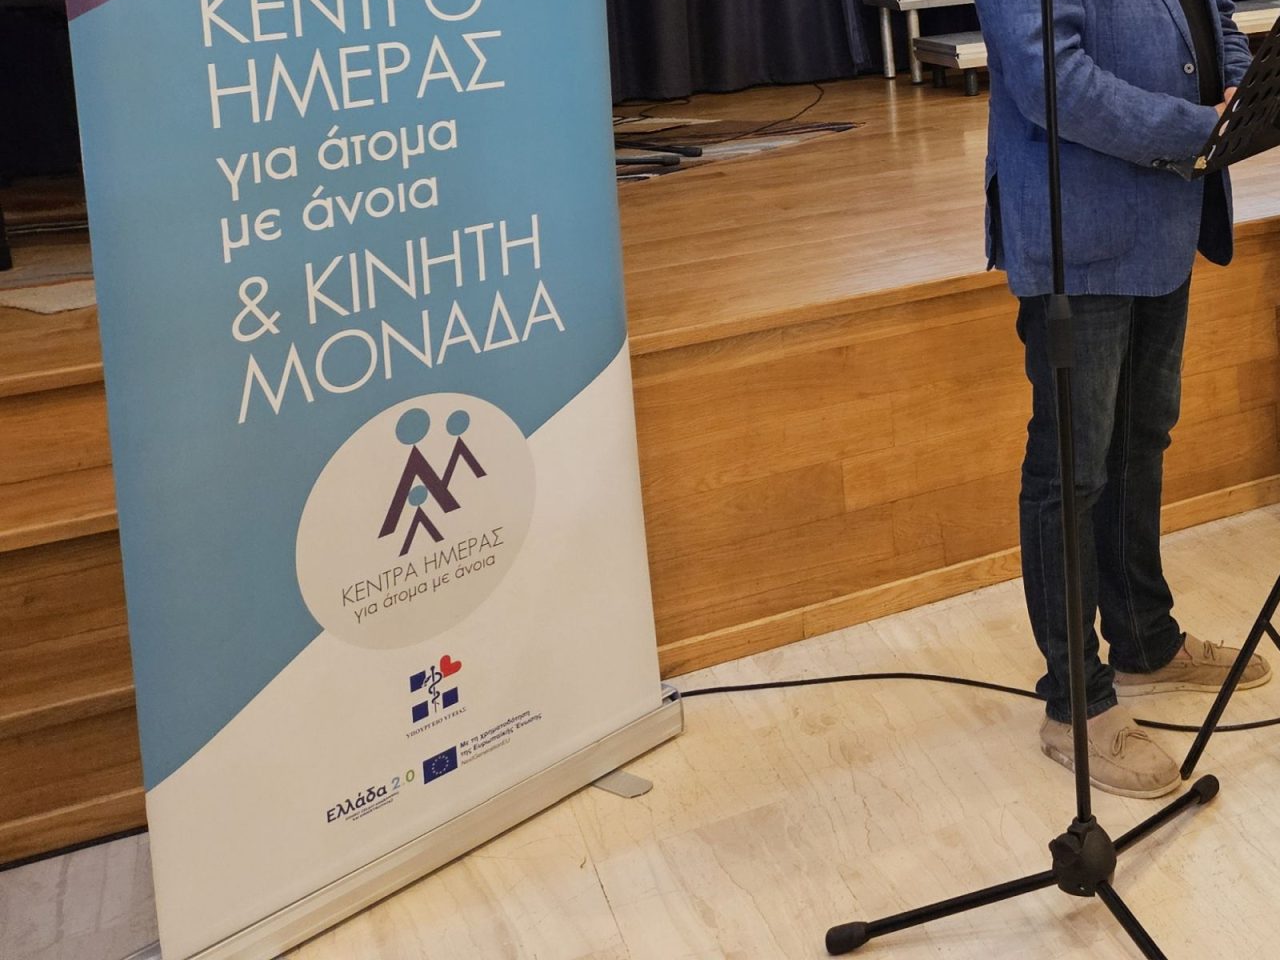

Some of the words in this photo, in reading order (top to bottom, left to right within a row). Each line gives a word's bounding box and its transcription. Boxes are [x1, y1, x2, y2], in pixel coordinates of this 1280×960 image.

[207, 30, 505, 129] ΗΜΕΡΑΣ
[216, 145, 298, 201] για
[317, 119, 459, 170] άτομα
[221, 207, 282, 263] με
[302, 176, 439, 231] άνοια
[231, 275, 281, 342] &
[305, 213, 542, 325] ΚΙΝΗΤΗ
[238, 279, 566, 425] ΜΟΝΑΔΑ
[341, 561, 419, 607] ΚΕΝΤΡΑ
[423, 526, 505, 574] ΗΜΕΡΑΣ
[354, 601, 379, 624] για
[383, 581, 428, 609] άτομα
[432, 571, 450, 592] με
[454, 553, 496, 580] άνοια
[326, 785, 388, 823] Ελλάδα
[391, 769, 415, 791] 2.0
